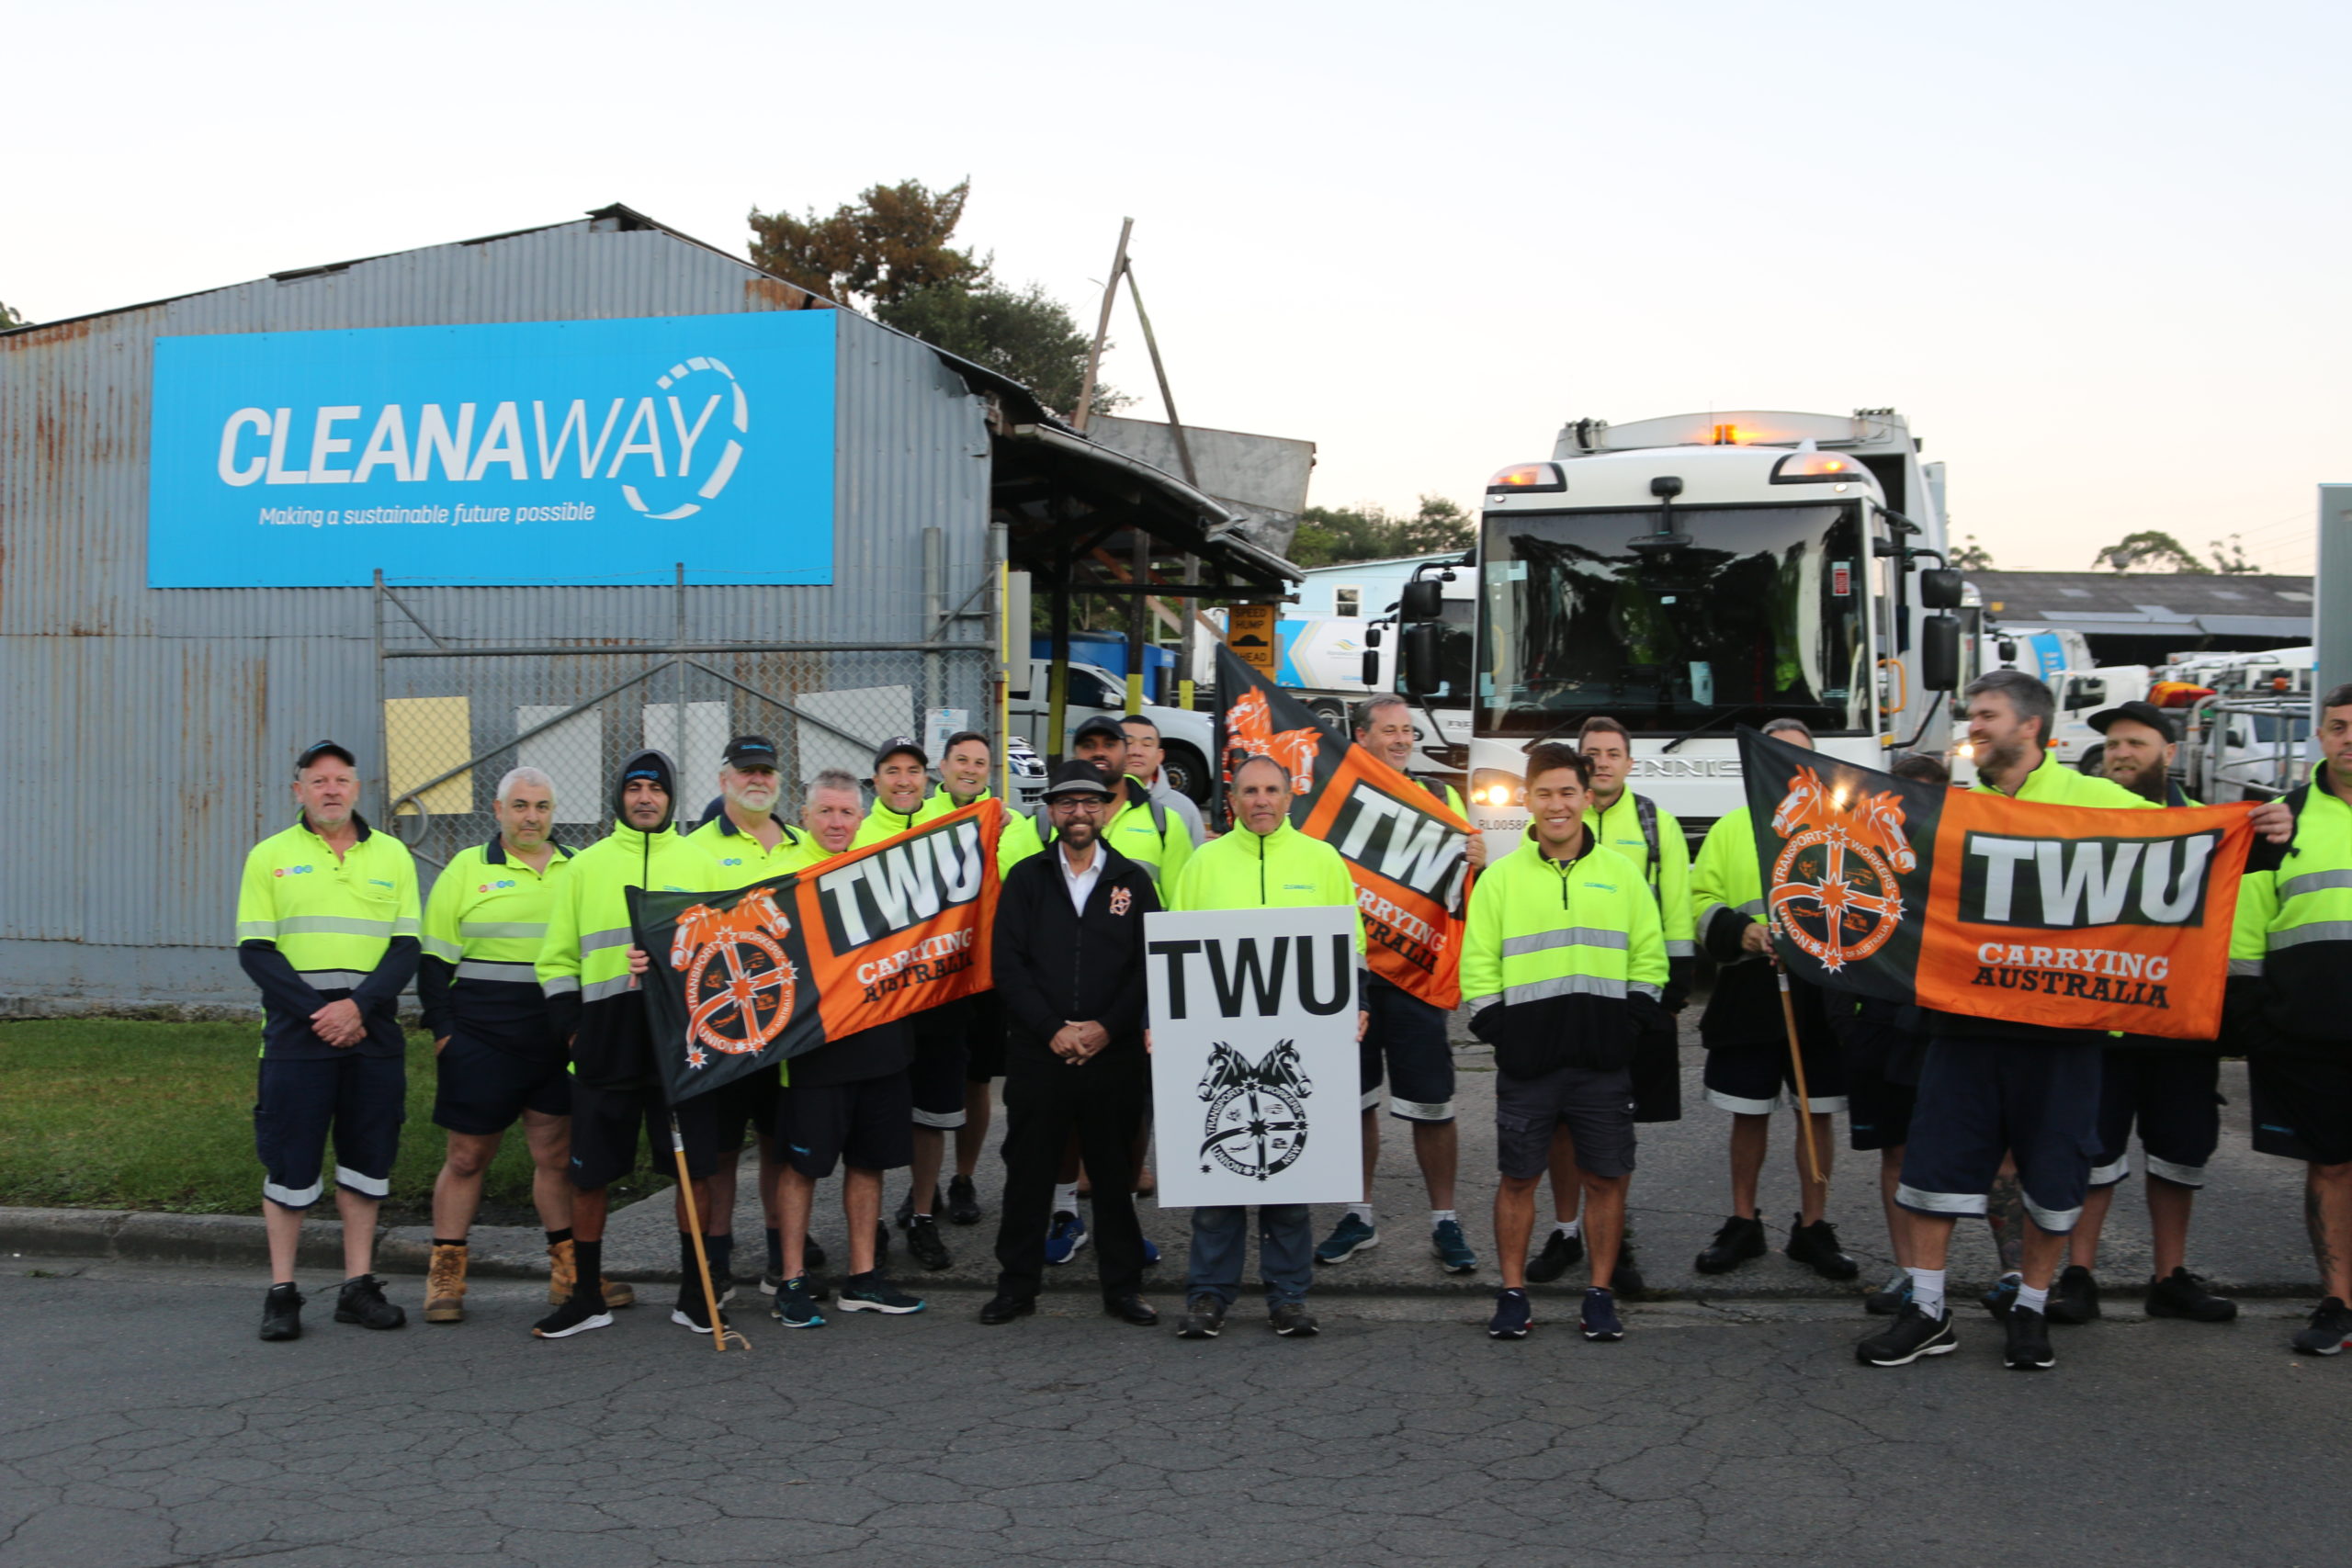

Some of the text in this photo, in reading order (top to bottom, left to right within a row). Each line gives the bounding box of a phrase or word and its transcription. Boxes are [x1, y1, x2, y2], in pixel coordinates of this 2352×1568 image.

[218, 394, 722, 487] CLEANAWAY
[258, 502, 595, 527] Making a sustainable future possible
[1235, 608, 1266, 617] SPEED
[1236, 620, 1265, 630] HUMP
[1626, 759, 1744, 777] ENNIS
[1774, 830, 1823, 883] TRANSPORT
[819, 822, 983, 946] TWU
[1971, 834, 2214, 926] TWU
[1352, 882, 1448, 952] RRYING
[1778, 905, 1810, 948] UNION
[1856, 924, 1890, 956] AUSTRALIA
[1148, 934, 1351, 1020] TWU
[1977, 942, 2169, 981] CARRYING
[1972, 966, 2170, 1009] AUSTRALIA
[698, 1026, 734, 1052] UNION
[1206, 1087, 1242, 1134] TRANSPORT
[1212, 1146, 1244, 1173] UNION
[1281, 1144, 1302, 1165] NSW
